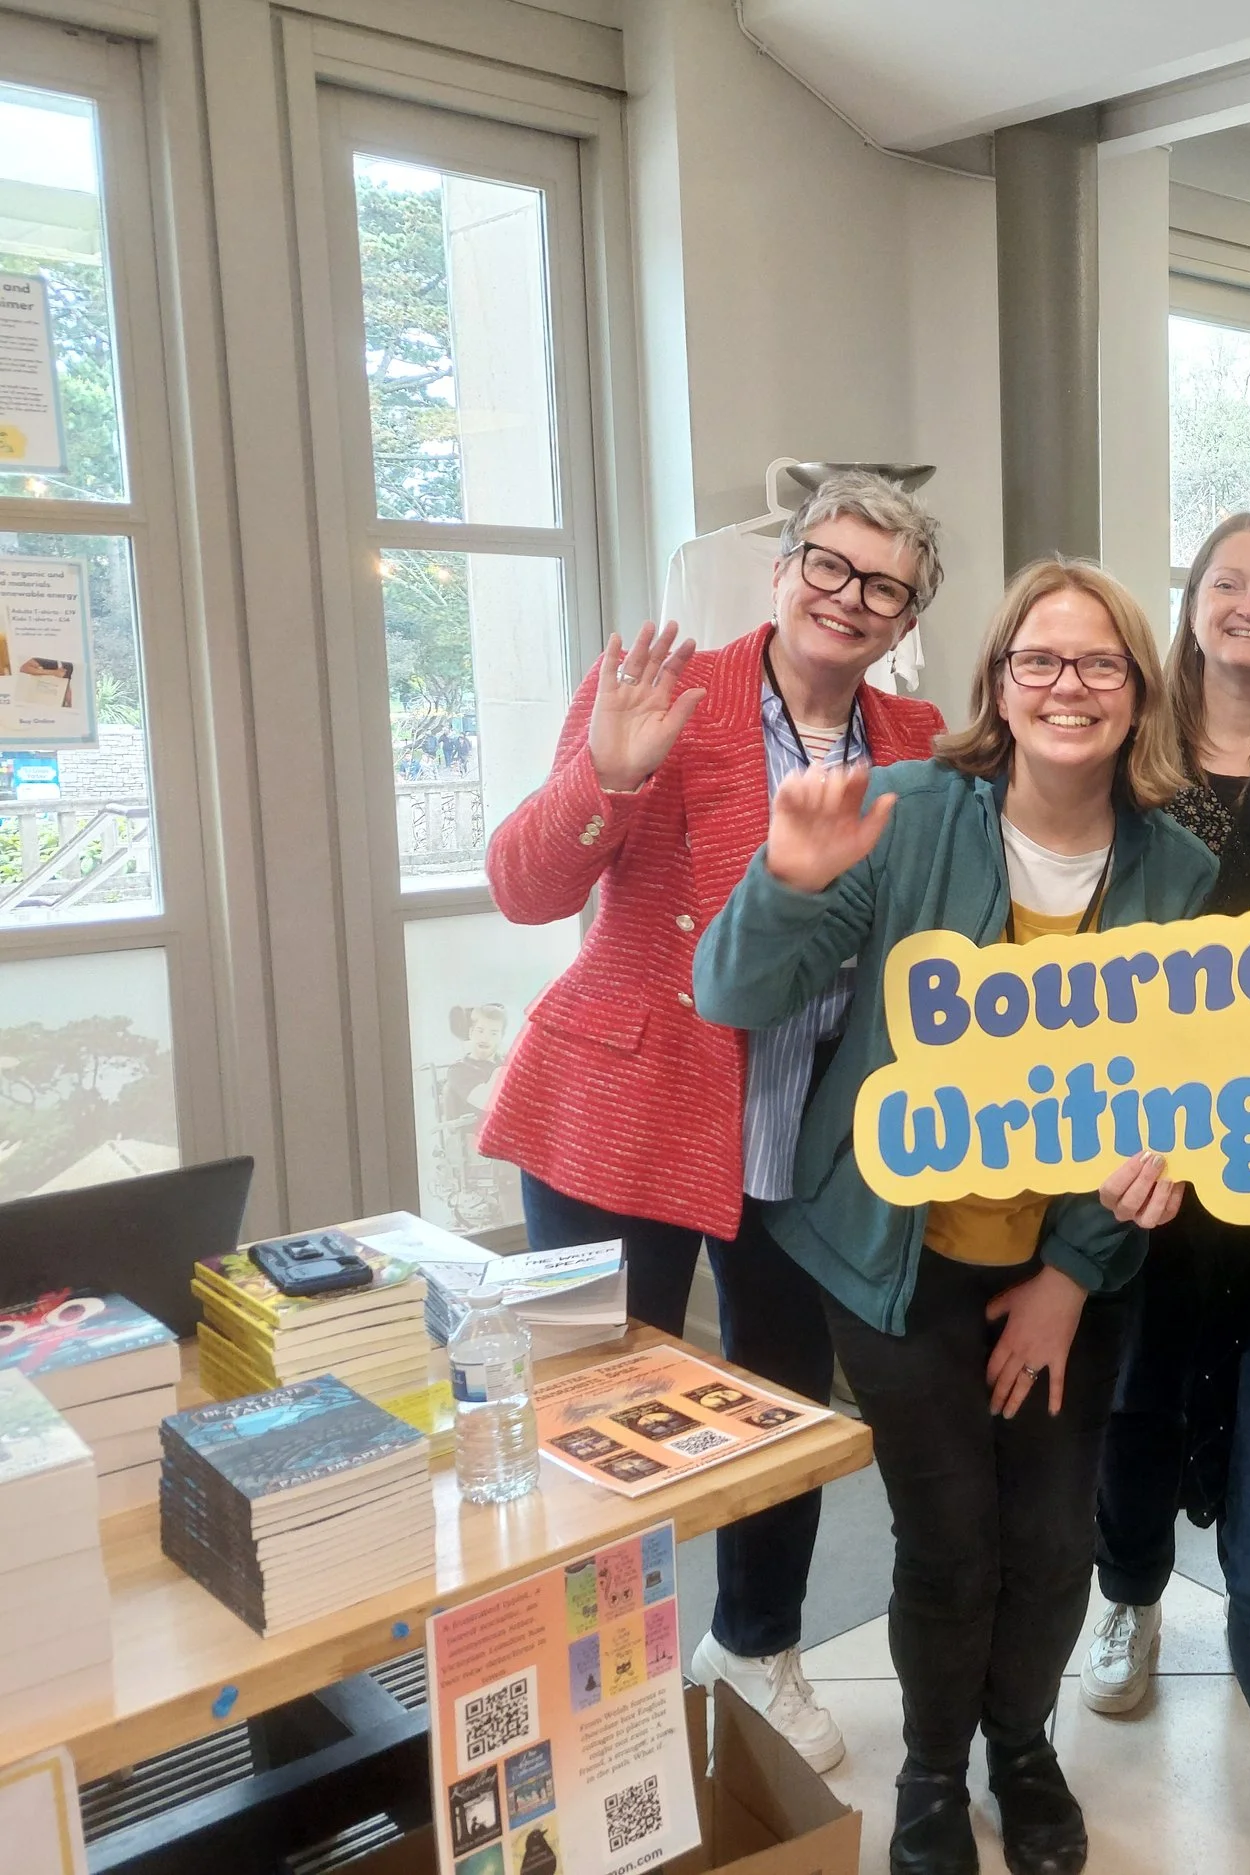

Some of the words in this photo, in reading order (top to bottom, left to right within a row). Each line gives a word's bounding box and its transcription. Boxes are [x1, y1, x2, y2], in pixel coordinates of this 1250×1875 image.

[3, 283, 30, 293] and
[544, 1257, 597, 1270] SPEAK
[279, 1468, 319, 1488] PAUL
[489, 1634, 526, 1654] London
[604, 1704, 629, 1720] Welsh
[620, 1713, 635, 1724] box
[637, 1698, 667, 1715] English
[651, 1709, 666, 1720] that
